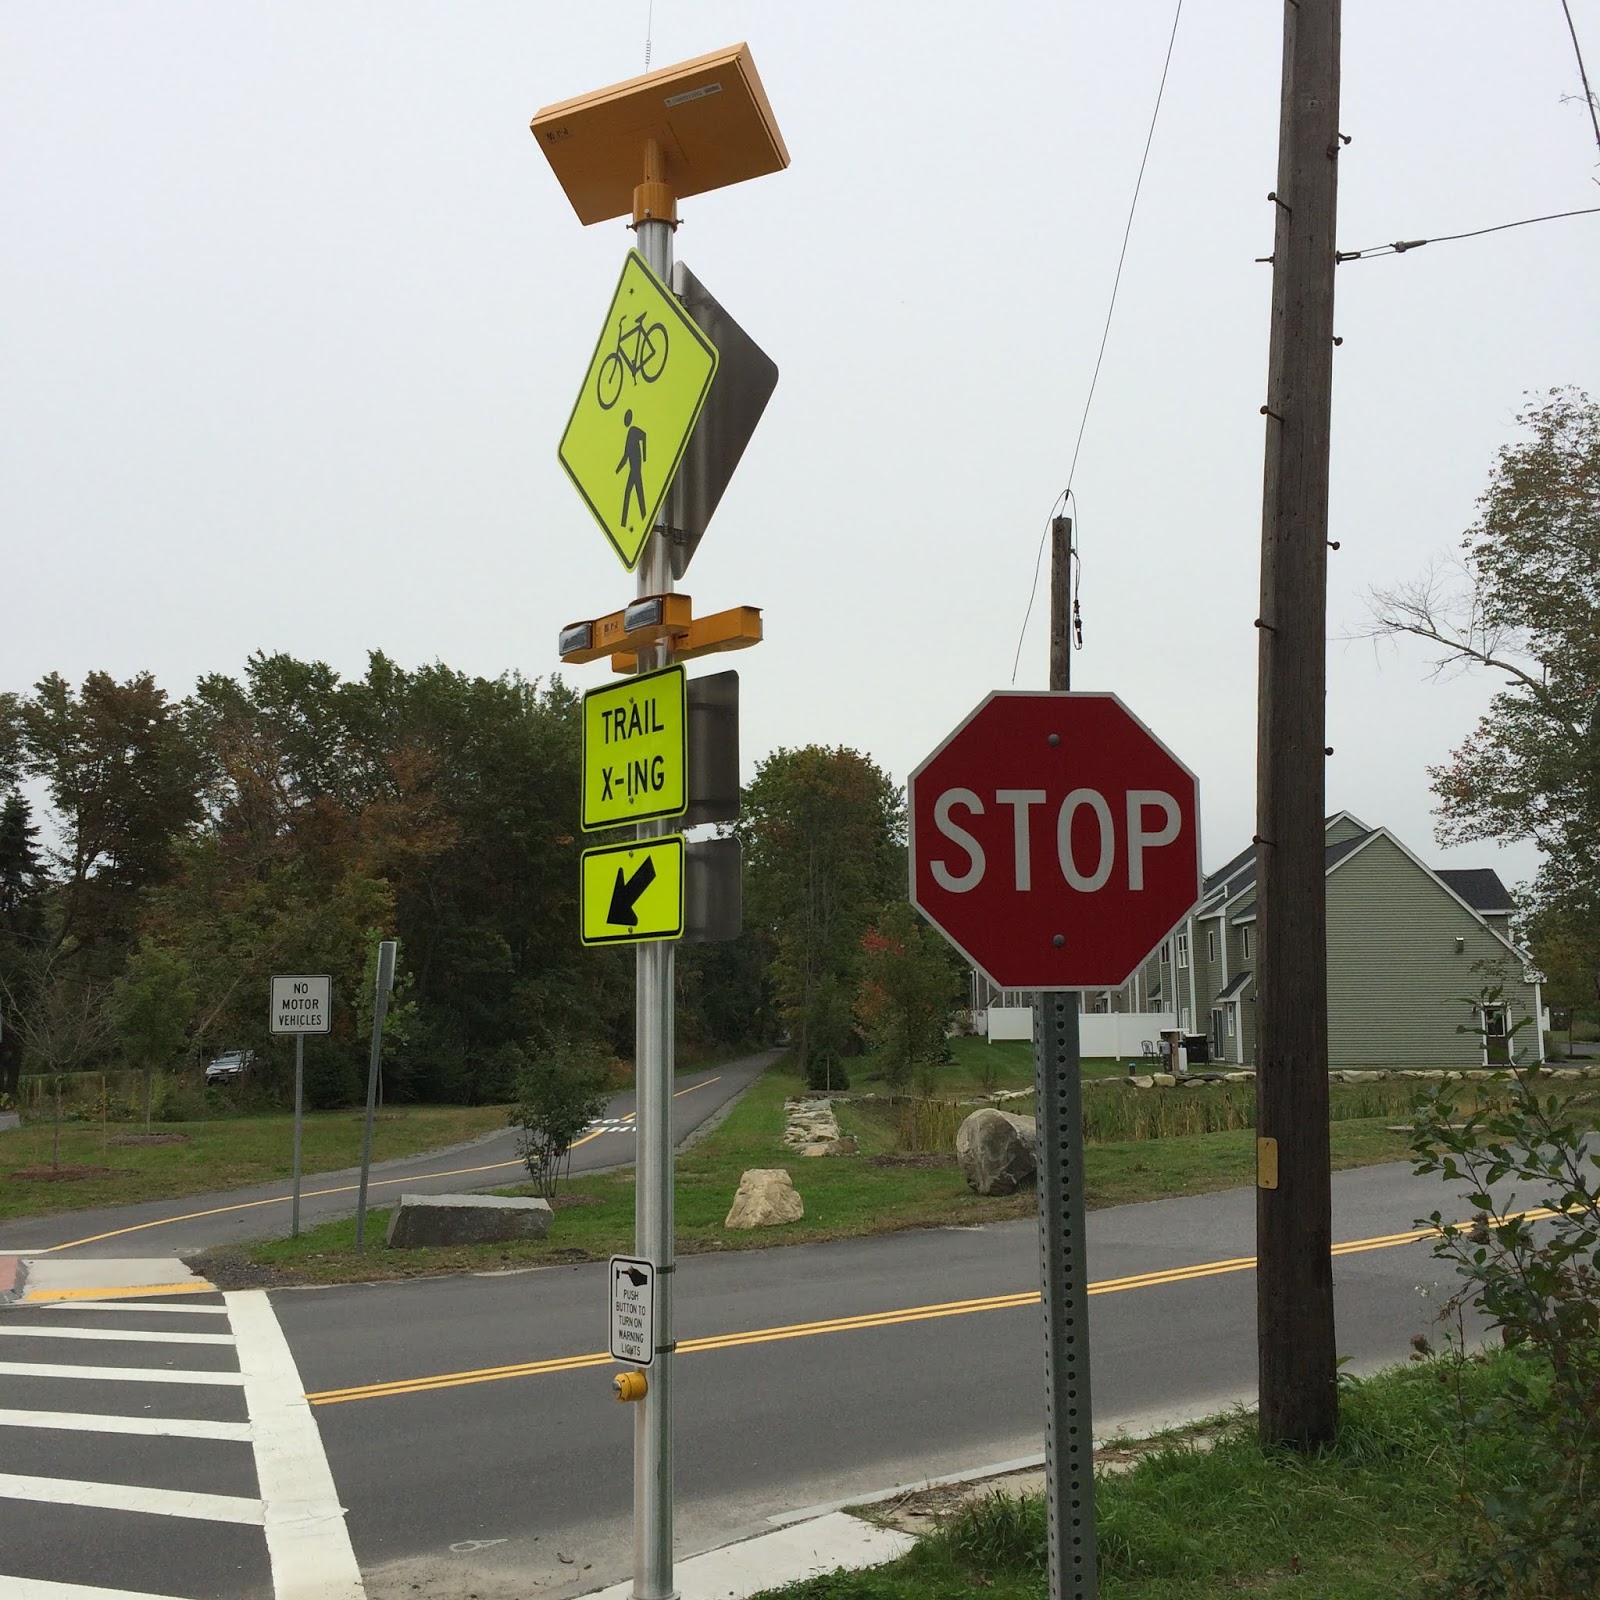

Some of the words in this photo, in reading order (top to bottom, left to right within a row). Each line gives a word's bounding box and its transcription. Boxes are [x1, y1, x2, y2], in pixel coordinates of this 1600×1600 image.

[601, 698, 664, 744] TRAIL
[601, 755, 665, 802] X-ING
[930, 787, 1182, 893] STOP
[294, 983, 308, 994] NO
[282, 999, 319, 1010] MOTOR
[279, 1014, 322, 1026] VEHICLES
[623, 1289, 639, 1301] PUSH
[616, 1301, 637, 1314] BUTTON
[638, 1305, 646, 1316] TO
[619, 1315, 633, 1327] TURN
[634, 1317, 642, 1328] ON
[619, 1329, 644, 1343] WARNING
[621, 1343, 641, 1356] LIGHTS
